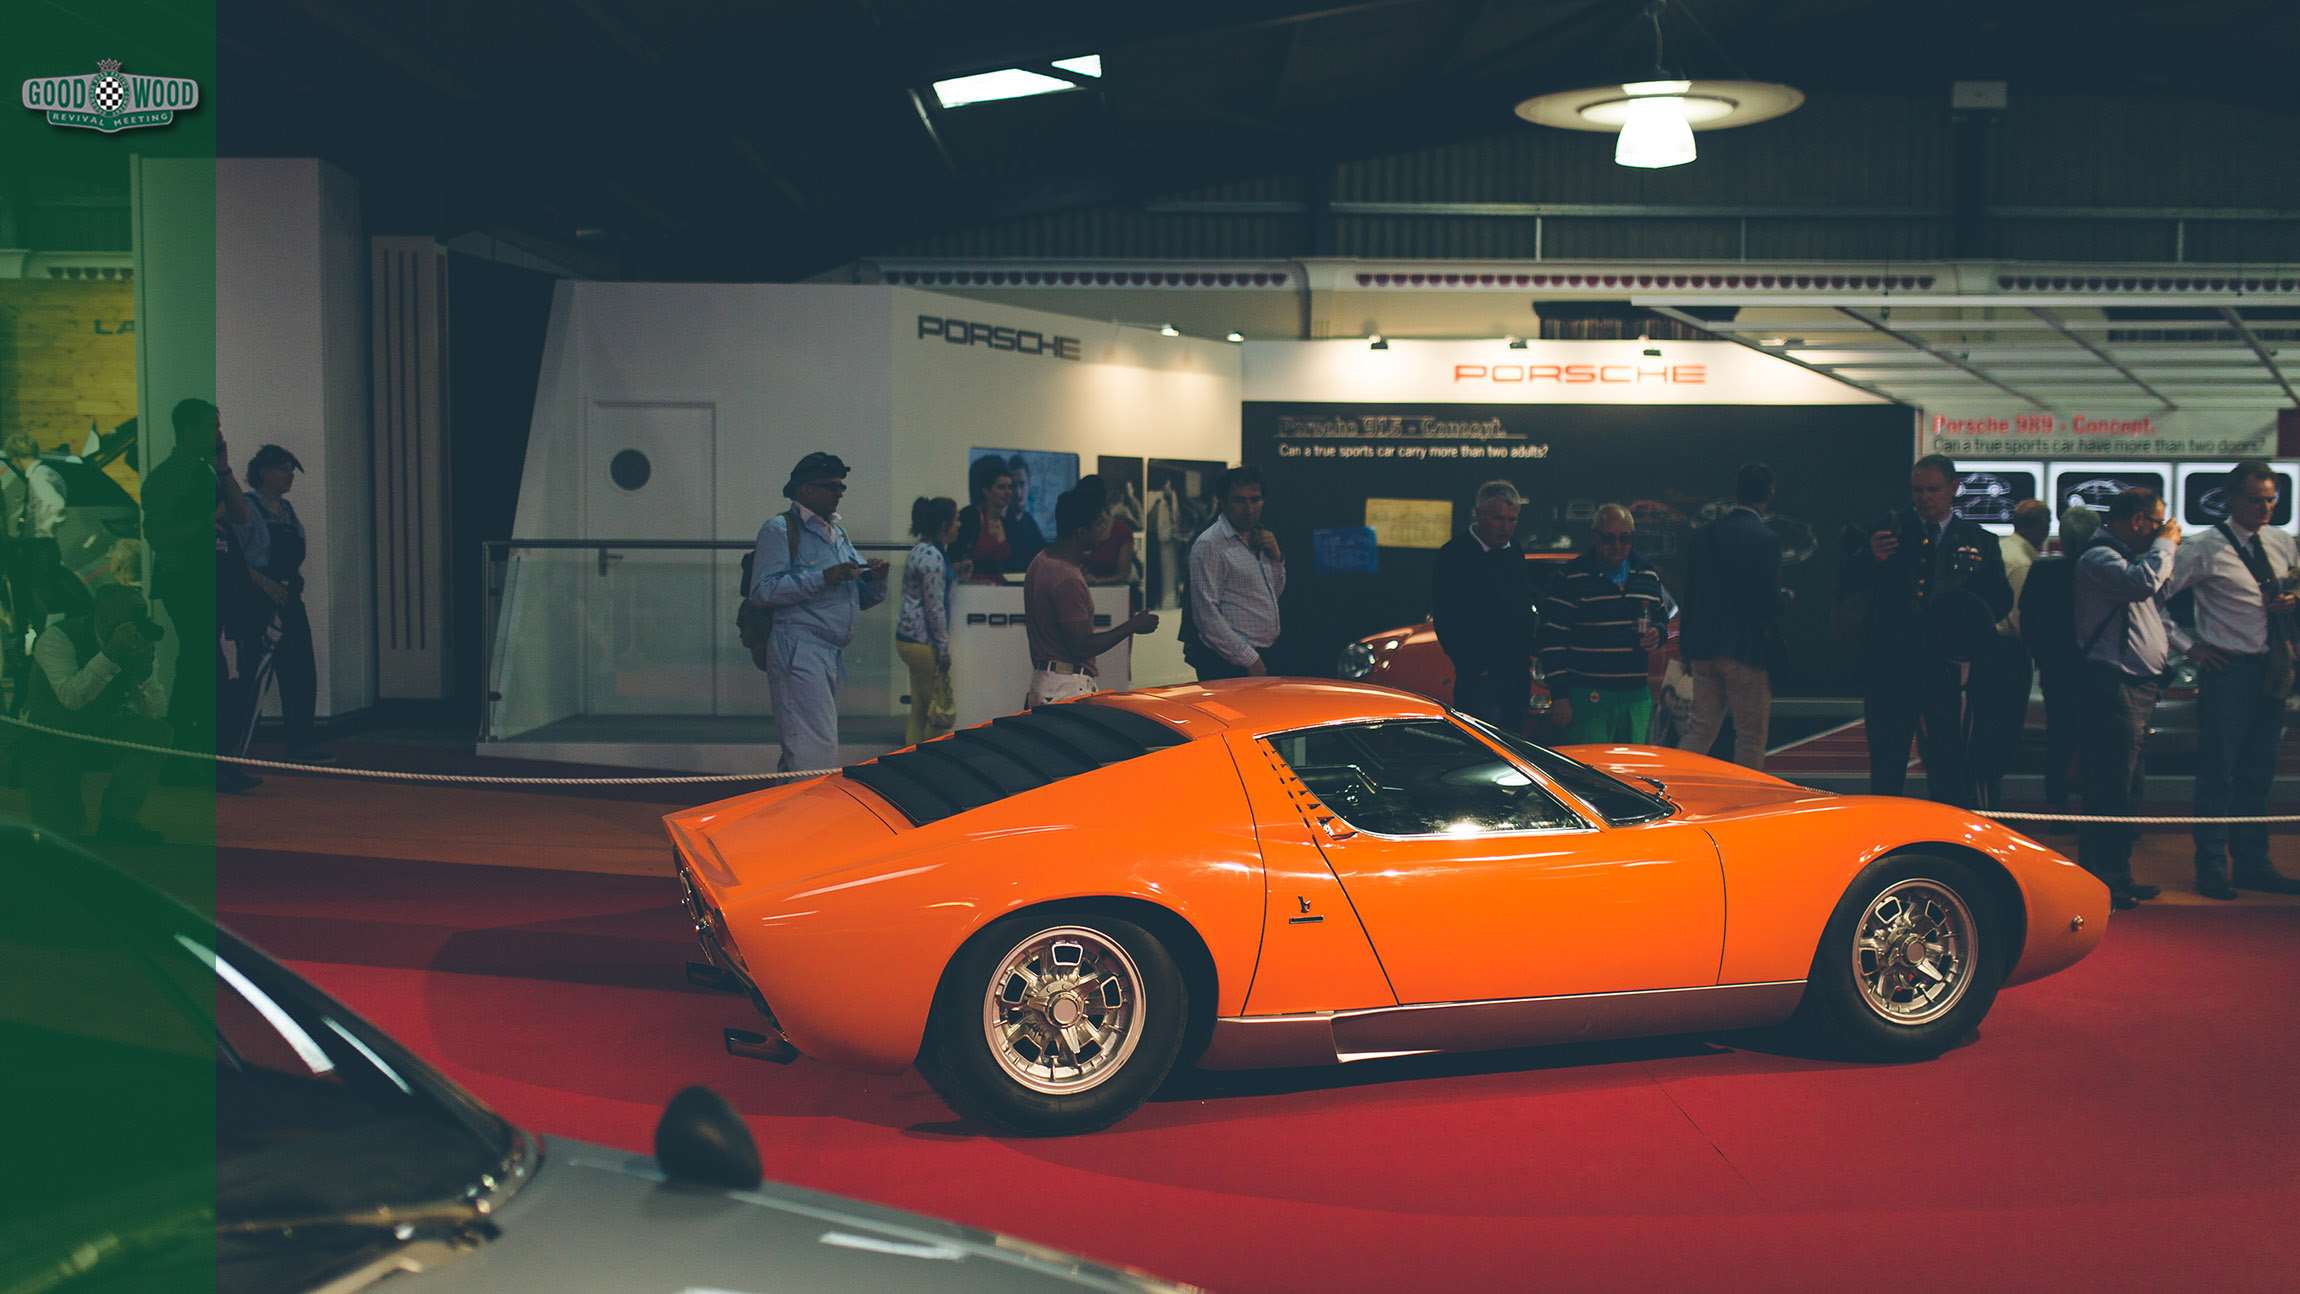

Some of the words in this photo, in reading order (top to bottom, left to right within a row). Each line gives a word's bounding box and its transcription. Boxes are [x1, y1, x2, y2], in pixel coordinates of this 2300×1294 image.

[918, 315, 1081, 361] PORSCHE
[1453, 364, 1708, 384] PORSCHE
[1932, 415, 2009, 434] Porsche
[2015, 415, 2053, 433] 989
[1279, 443, 1301, 457] Can
[1304, 447, 1312, 457] a
[1315, 445, 1336, 457] true
[1340, 445, 1374, 458] sports
[1376, 447, 1396, 457] car
[1398, 447, 1427, 460] carry
[1430, 447, 1459, 457] more
[1461, 445, 1485, 457] than
[1487, 445, 1509, 457] two
[1511, 443, 1549, 458] adults?
[1934, 436, 1960, 450] Can
[1974, 438, 2001, 450] true
[2005, 438, 2049, 453] sports
[2053, 441, 2075, 451] car
[2079, 438, 2111, 451] have
[2115, 441, 2150, 452] more
[2155, 439, 2185, 453] than
[2190, 439, 2214, 453] two
[967, 613, 1111, 627] PORE
